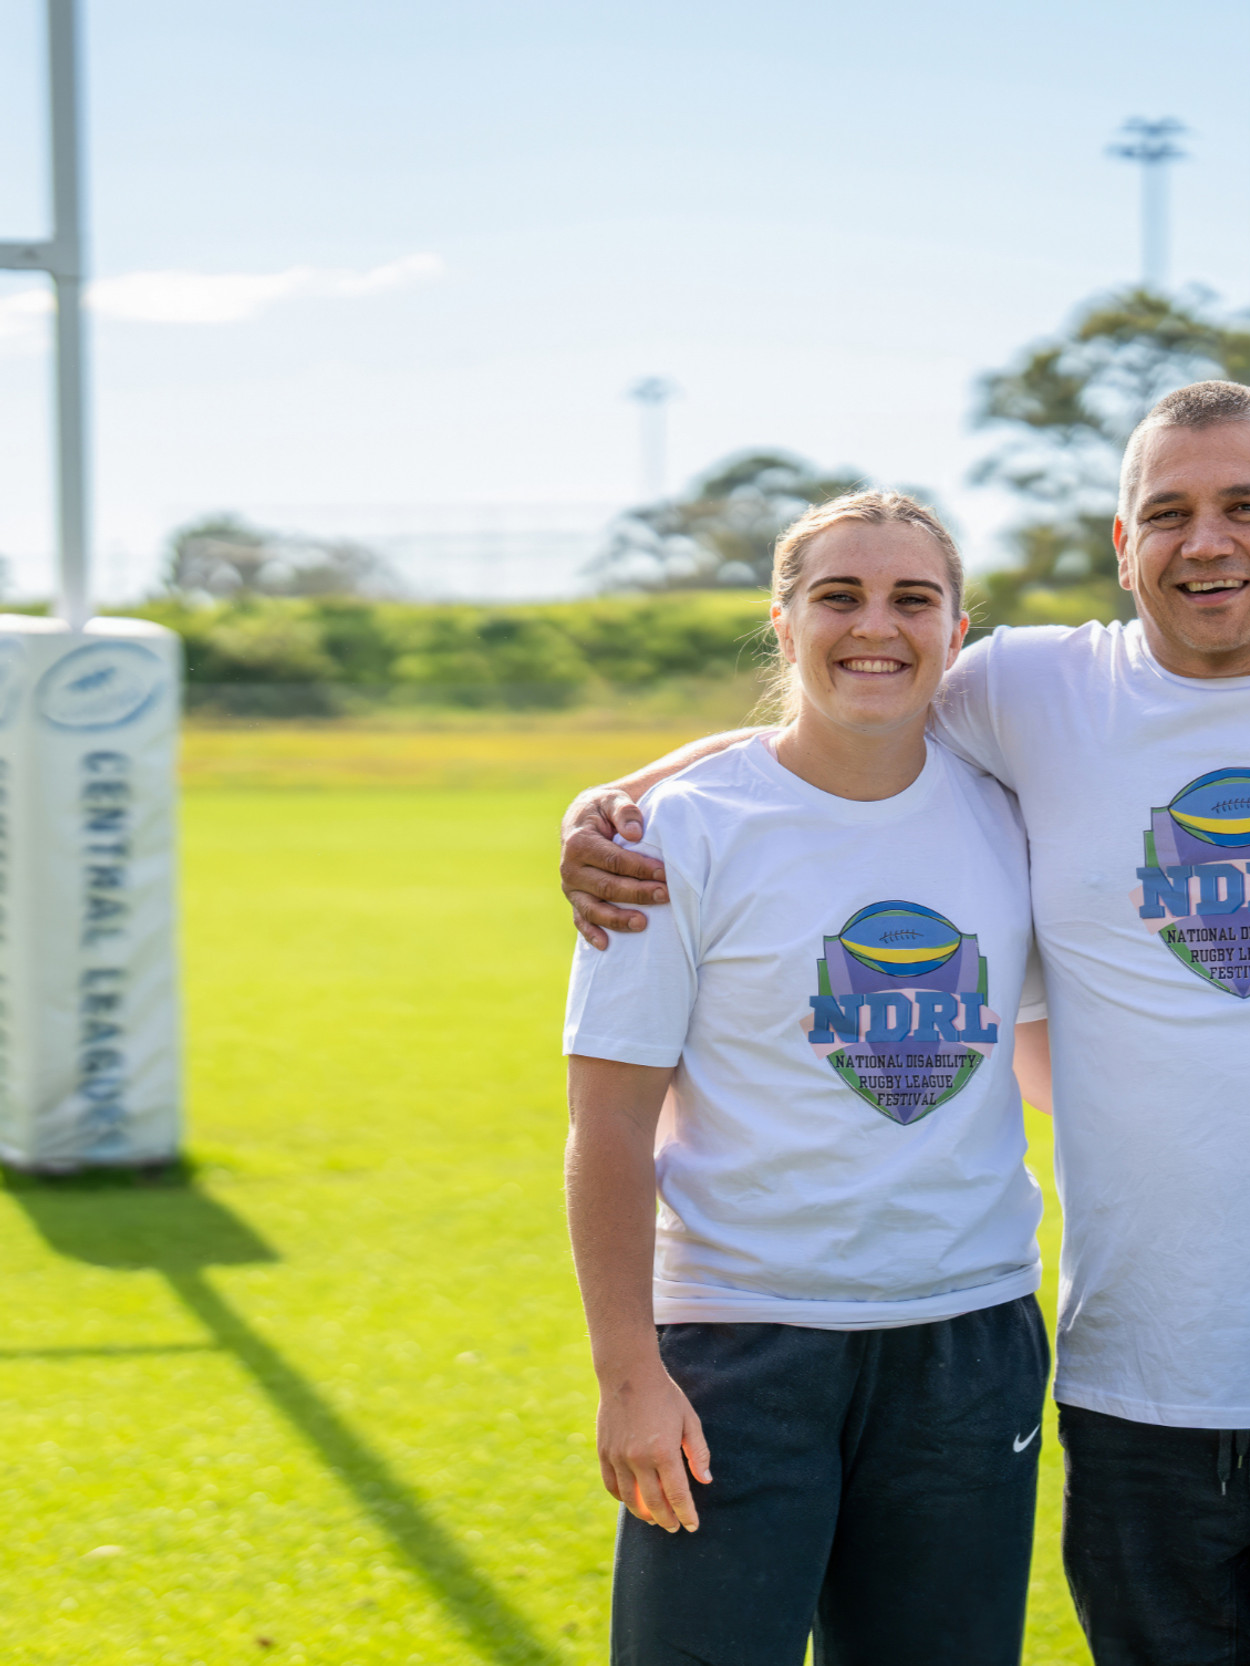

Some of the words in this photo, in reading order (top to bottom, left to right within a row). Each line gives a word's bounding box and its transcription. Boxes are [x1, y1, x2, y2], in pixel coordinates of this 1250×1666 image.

[1167, 926, 1238, 943] NATIONAL
[1190, 947, 1236, 963] RUGBY
[808, 991, 998, 1044] NDRL
[835, 1055, 904, 1069] NATIONAL
[906, 1054, 977, 1068] DISABILITY
[859, 1075, 902, 1089] RUGBY
[904, 1074, 953, 1088] LEAGUE
[877, 1092, 937, 1106] FESTIVAL
